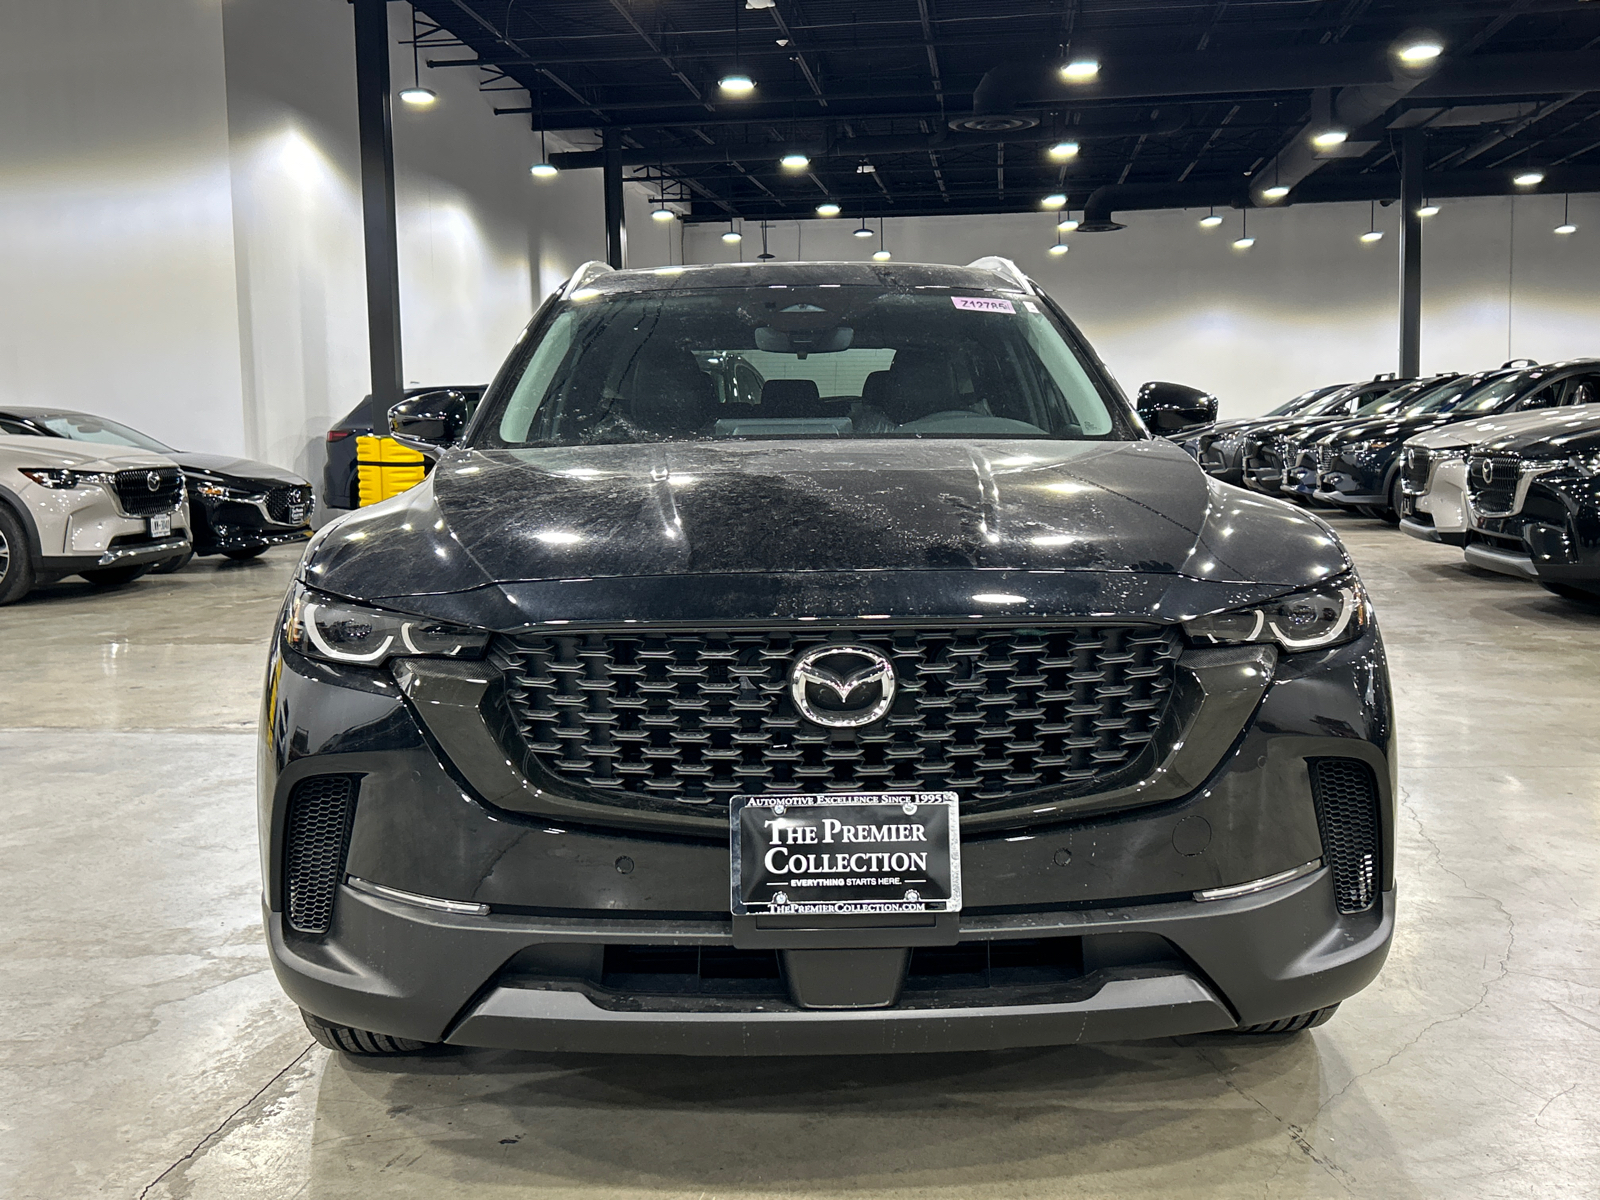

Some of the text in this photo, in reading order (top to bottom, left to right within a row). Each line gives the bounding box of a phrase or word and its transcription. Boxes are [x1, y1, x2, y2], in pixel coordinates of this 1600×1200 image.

[747, 794, 942, 807] AUTOMOTIVE EXCELLENCE SINCE 1995
[764, 818, 927, 845] THE PREMIER
[764, 847, 928, 875] COLLECTION
[790, 877, 902, 887] EVERYTHING STARTS HERE.
